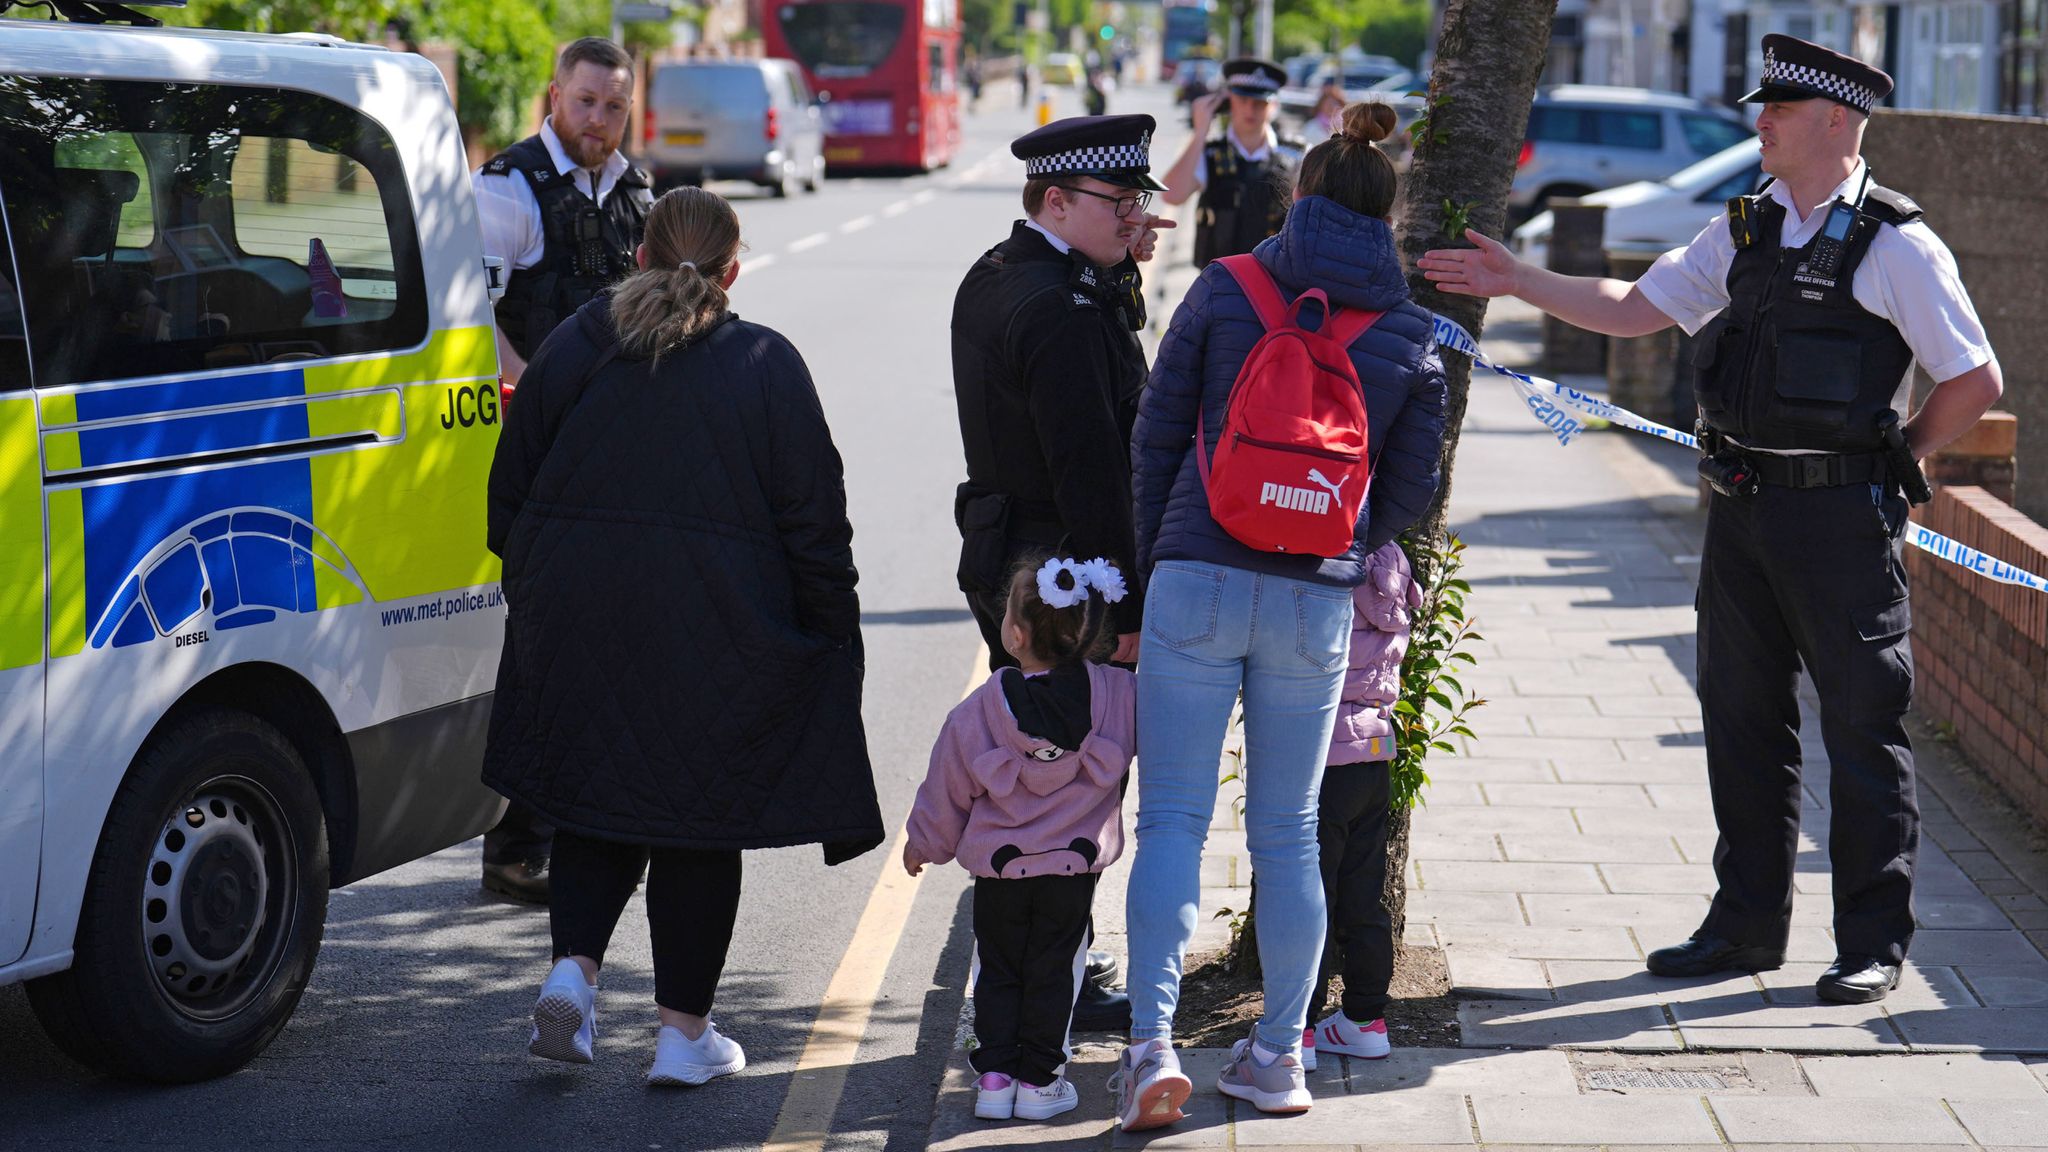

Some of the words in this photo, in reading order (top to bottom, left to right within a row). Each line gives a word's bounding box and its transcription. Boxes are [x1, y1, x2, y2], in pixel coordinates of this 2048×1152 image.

[1084, 266, 1094, 277] EA
[1793, 275, 1812, 283] POLICE
[1812, 277, 1836, 287] OFFICER
[441, 384, 498, 430] JCG
[1260, 482, 1331, 515] PUMA
[381, 586, 503, 627] www.met.police.uk
[175, 630, 210, 648] DIESEL
